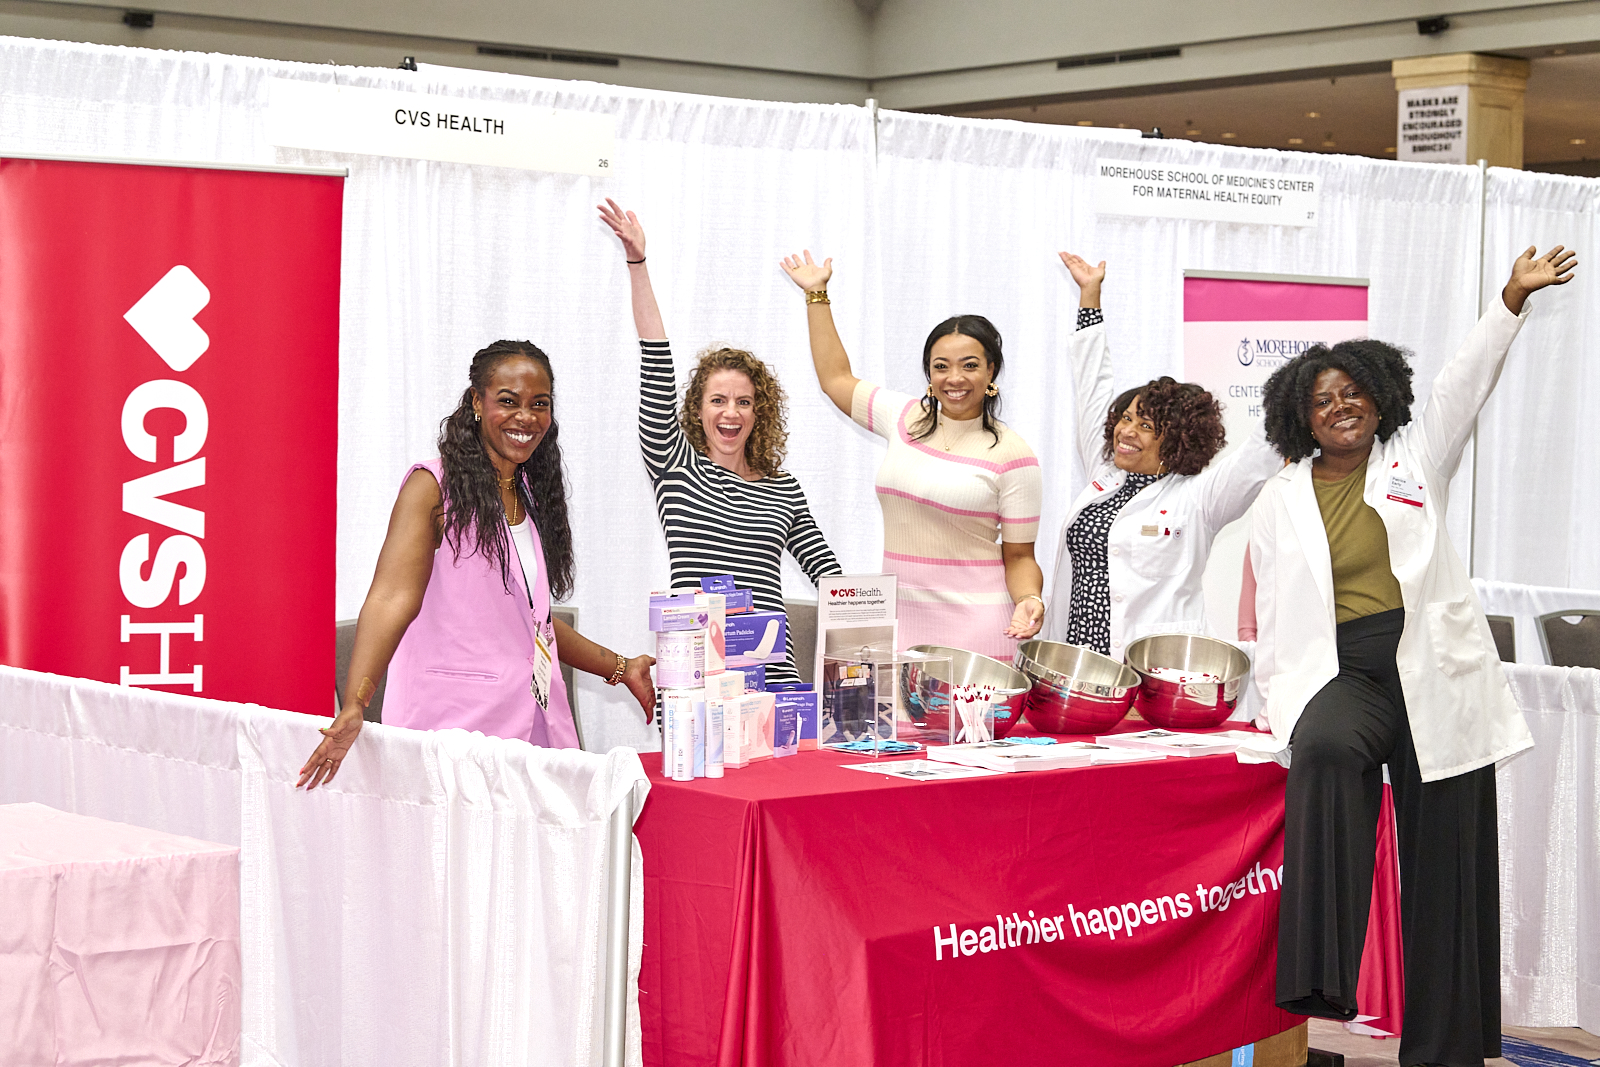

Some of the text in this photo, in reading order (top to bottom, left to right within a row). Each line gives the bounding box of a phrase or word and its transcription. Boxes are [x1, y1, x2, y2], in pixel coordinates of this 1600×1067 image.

[1407, 95, 1458, 107] MASKS ARE
[1409, 108, 1455, 119] STRONGLY
[394, 108, 505, 135] CVS HEALTH
[1402, 119, 1462, 131] ENCOURAGED
[1402, 130, 1462, 142] THROUGHOUT
[598, 158, 609, 168] 26
[1100, 165, 1315, 193] MOREHOUSE SCHOOL OF MEDICINE'S CENTER
[1132, 185, 1283, 207] FOR MATERNAL HEALTH EQUITY
[1306, 211, 1315, 220] 27
[1256, 339, 1327, 360] MOREHOU
[933, 909, 1066, 961] Healthier
[1068, 890, 1193, 941] happens
